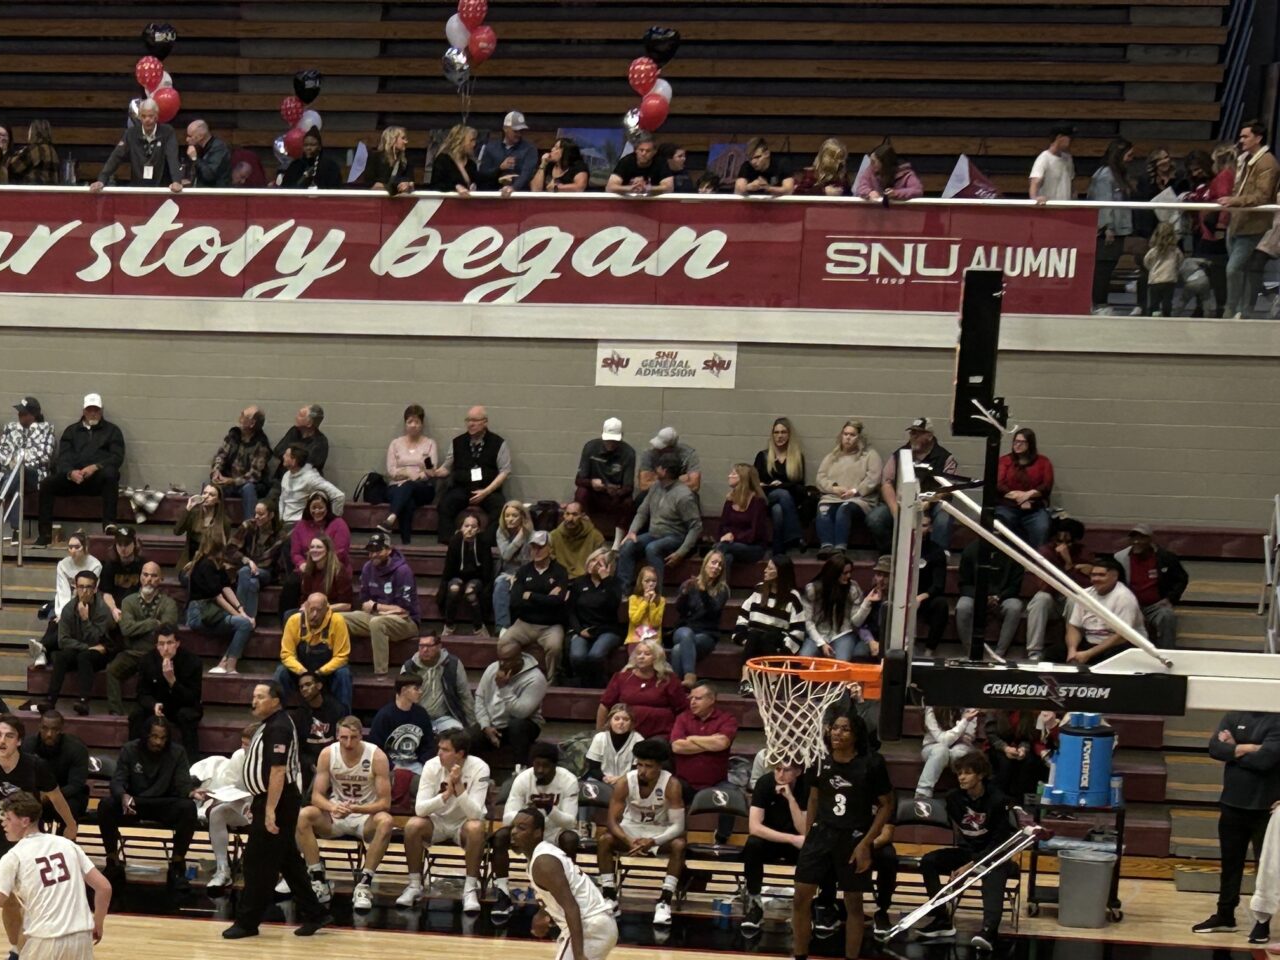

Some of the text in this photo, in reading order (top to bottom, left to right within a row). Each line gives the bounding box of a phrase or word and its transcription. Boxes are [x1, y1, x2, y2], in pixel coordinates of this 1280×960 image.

[76, 199, 347, 300] story
[370, 198, 730, 303] began
[825, 241, 1078, 279] SNU ALUMNI
[641, 359, 691, 369] GENERAL
[655, 351, 679, 360] SNU
[635, 367, 697, 377] ADMISSION
[982, 682, 1112, 699] CRIMSON STORM
[341, 783, 363, 797] 22
[832, 793, 847, 816] 3
[35, 852, 71, 888] 23
